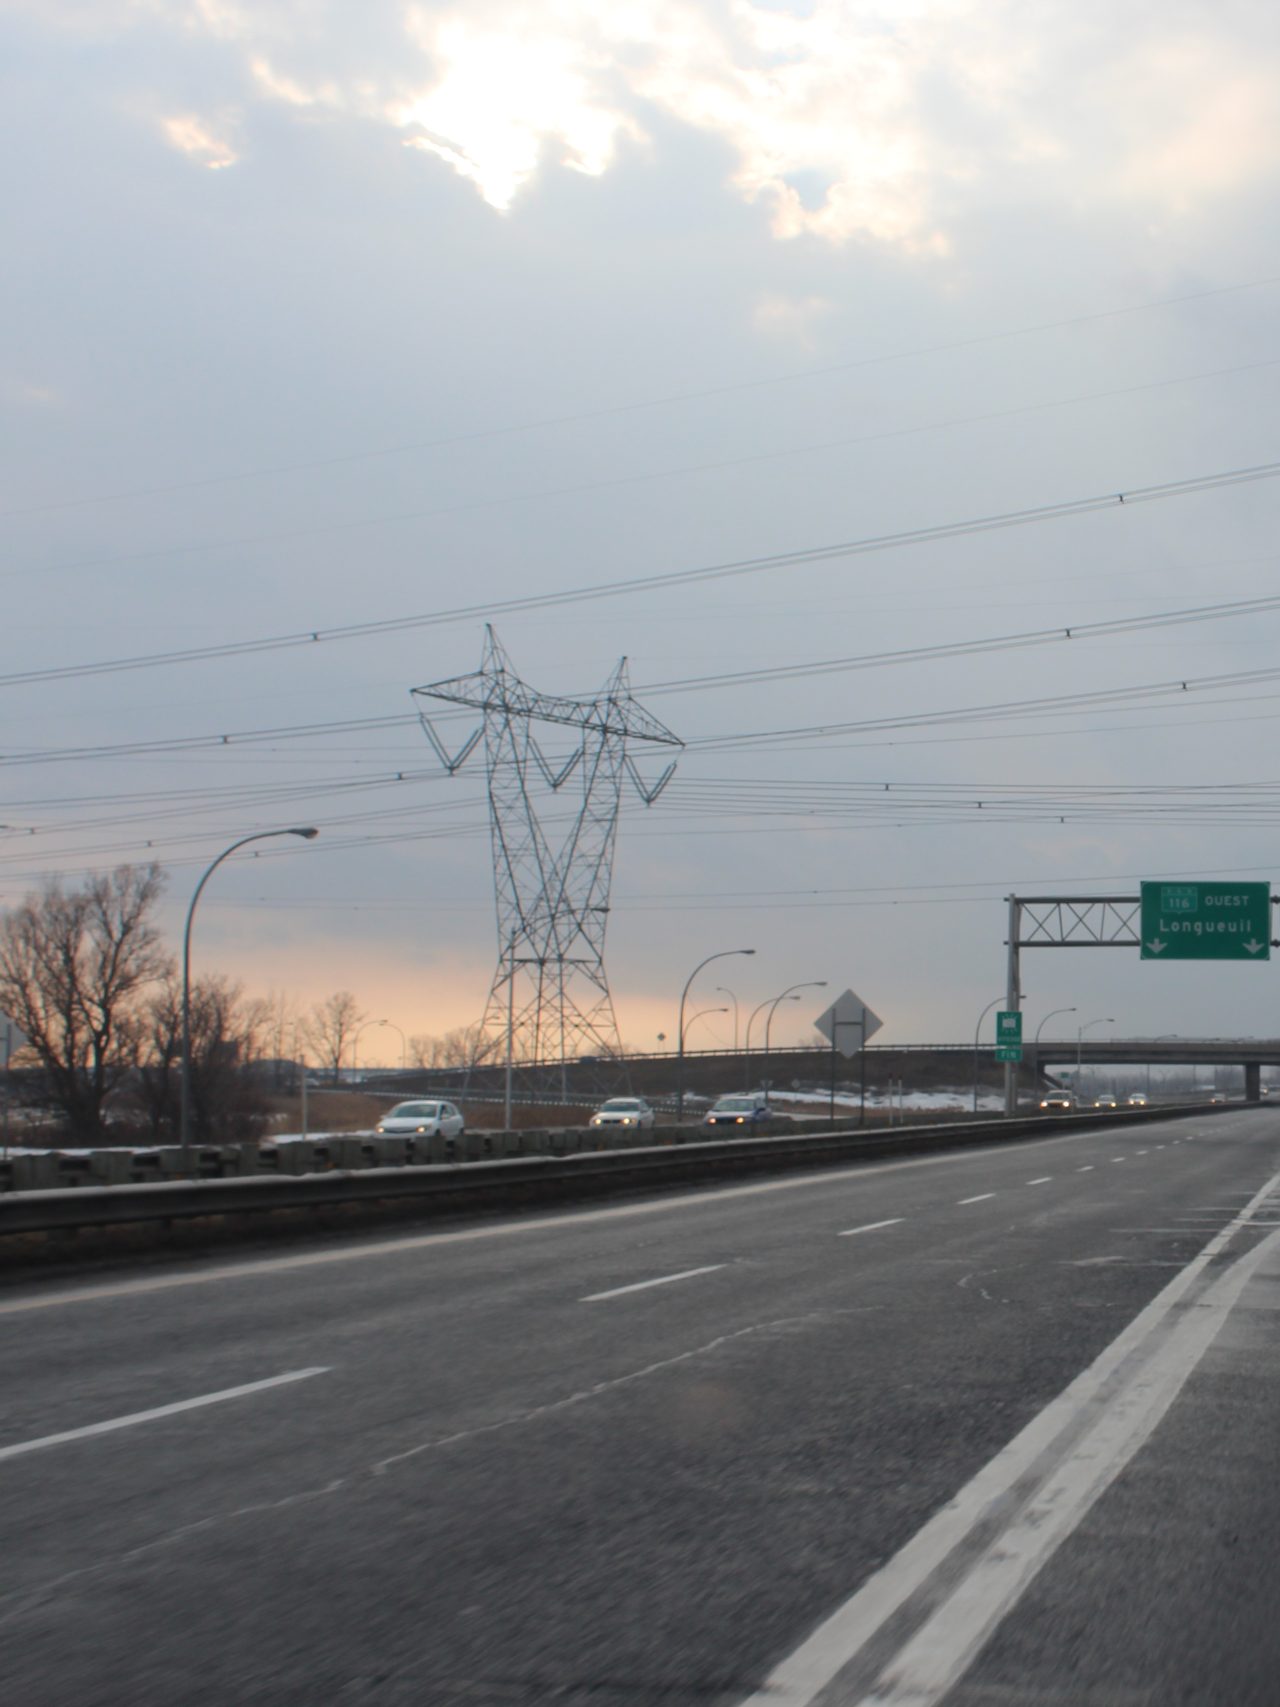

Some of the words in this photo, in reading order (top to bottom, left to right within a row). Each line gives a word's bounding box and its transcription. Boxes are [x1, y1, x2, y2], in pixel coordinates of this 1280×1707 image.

[1168, 897, 1190, 908] 116
[1204, 895, 1250, 906] OUEST
[1159, 918, 1251, 935] Longueuil
